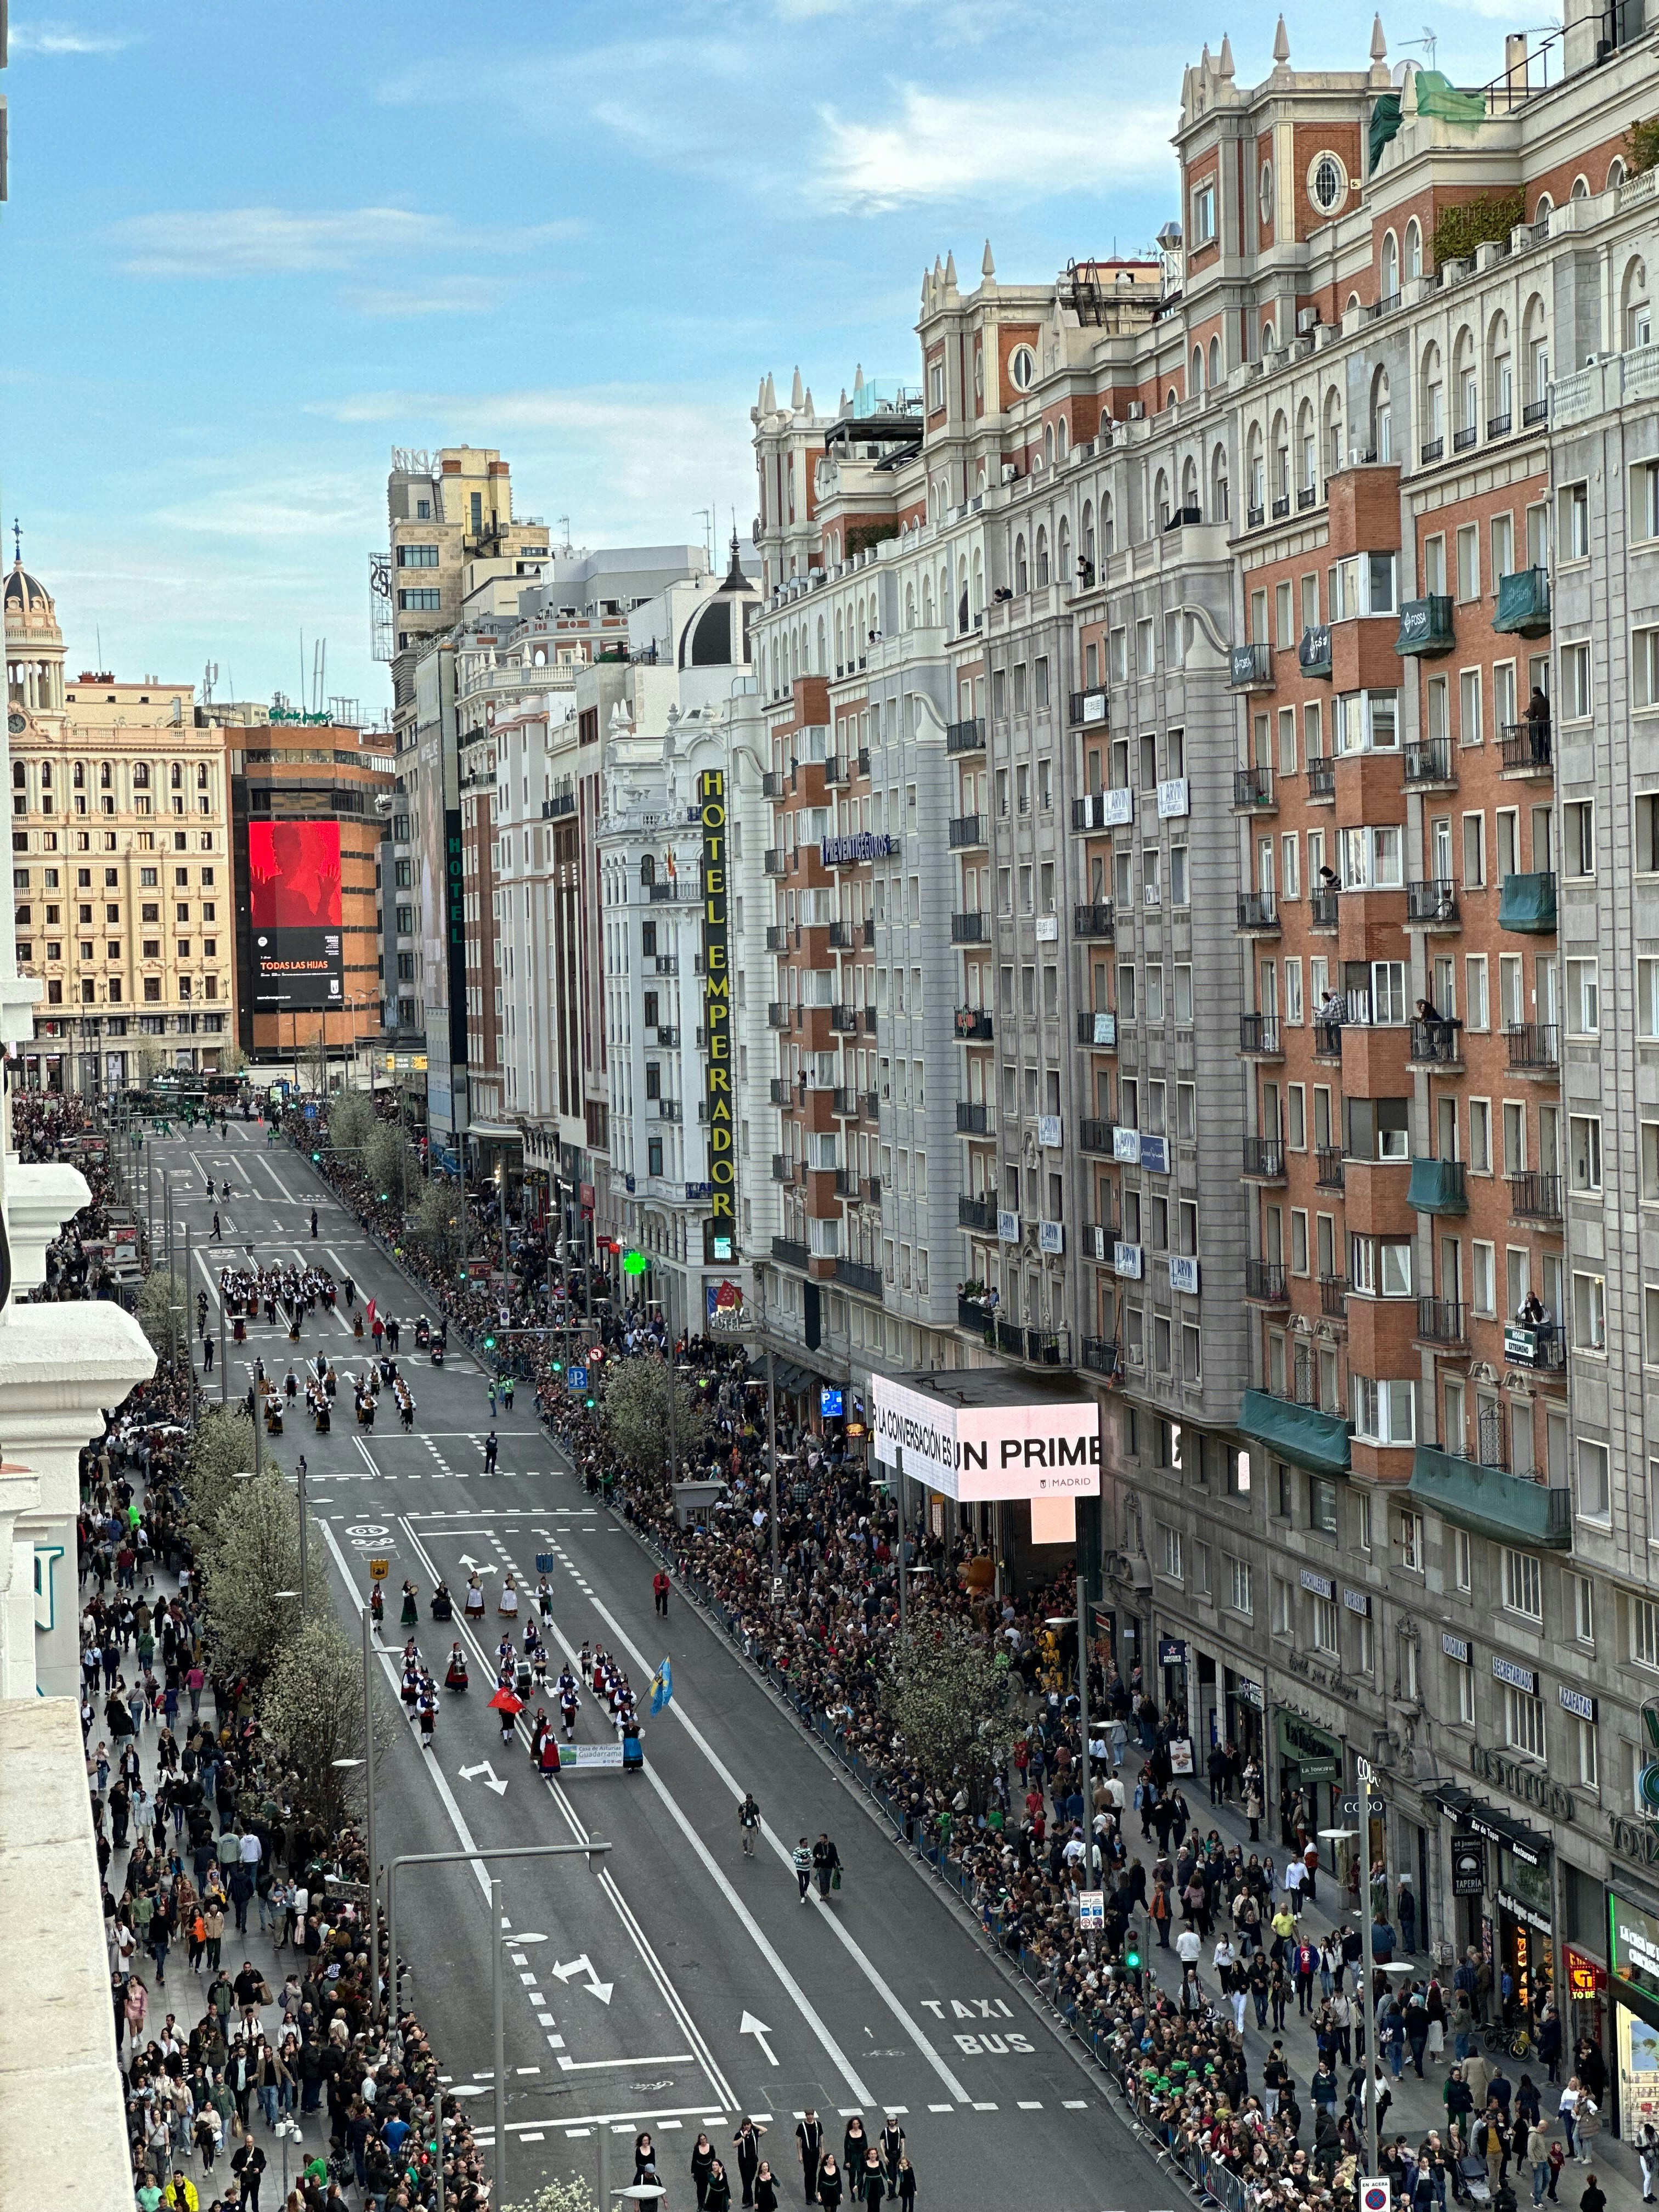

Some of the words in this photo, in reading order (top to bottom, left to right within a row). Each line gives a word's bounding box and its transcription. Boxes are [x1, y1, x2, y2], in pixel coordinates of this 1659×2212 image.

[1411, 612, 1426, 627] FOSSA
[1106, 791, 1128, 821] LARVIN
[1160, 781, 1183, 814] LARVIN
[702, 771, 725, 924] HOTEL
[449, 838, 462, 944] HOTEL
[260, 962, 290, 970] TODAS
[291, 961, 306, 969] LAS
[307, 960, 328, 969] HIJAS
[707, 945, 734, 1217] EMPERADOR
[1040, 1223, 1058, 1246] LARVIN
[1171, 1259, 1193, 1285] LARVIN
[1512, 1331, 1525, 1341] HOGAR
[573, 1371, 584, 1386] P
[822, 1393, 830, 1404] P
[879, 1407, 887, 1436] LA
[888, 1409, 939, 1462] CONVERSACIÓN
[941, 1432, 952, 1468] ES
[953, 1439, 988, 1471] UN
[1052, 1477, 1090, 1487] MADRID
[774, 1578, 782, 1589] P
[1301, 1571, 1331, 1599] BACHILLERATO
[1344, 1589, 1366, 1615] TURISMO
[1443, 1634, 1467, 1661] IDIOMAS
[1493, 1657, 1532, 1691] SECRETARIADO
[1560, 1686, 1591, 1718] AZAFATAS
[1469, 1743, 1574, 1822] INSTITUTO
[1472, 1820, 1480, 1831] Bar
[1481, 1825, 1487, 1835] de
[1513, 1843, 1538, 1865] Restaurante
[1455, 1878, 1481, 1888] TAPERÍA
[1620, 1925, 1629, 1942] LA
[1629, 1932, 1645, 1953] CASA
[1585, 1990, 1595, 1999] DE
[920, 1999, 1015, 2019] TAXI
[953, 2033, 1035, 2055] BUS
